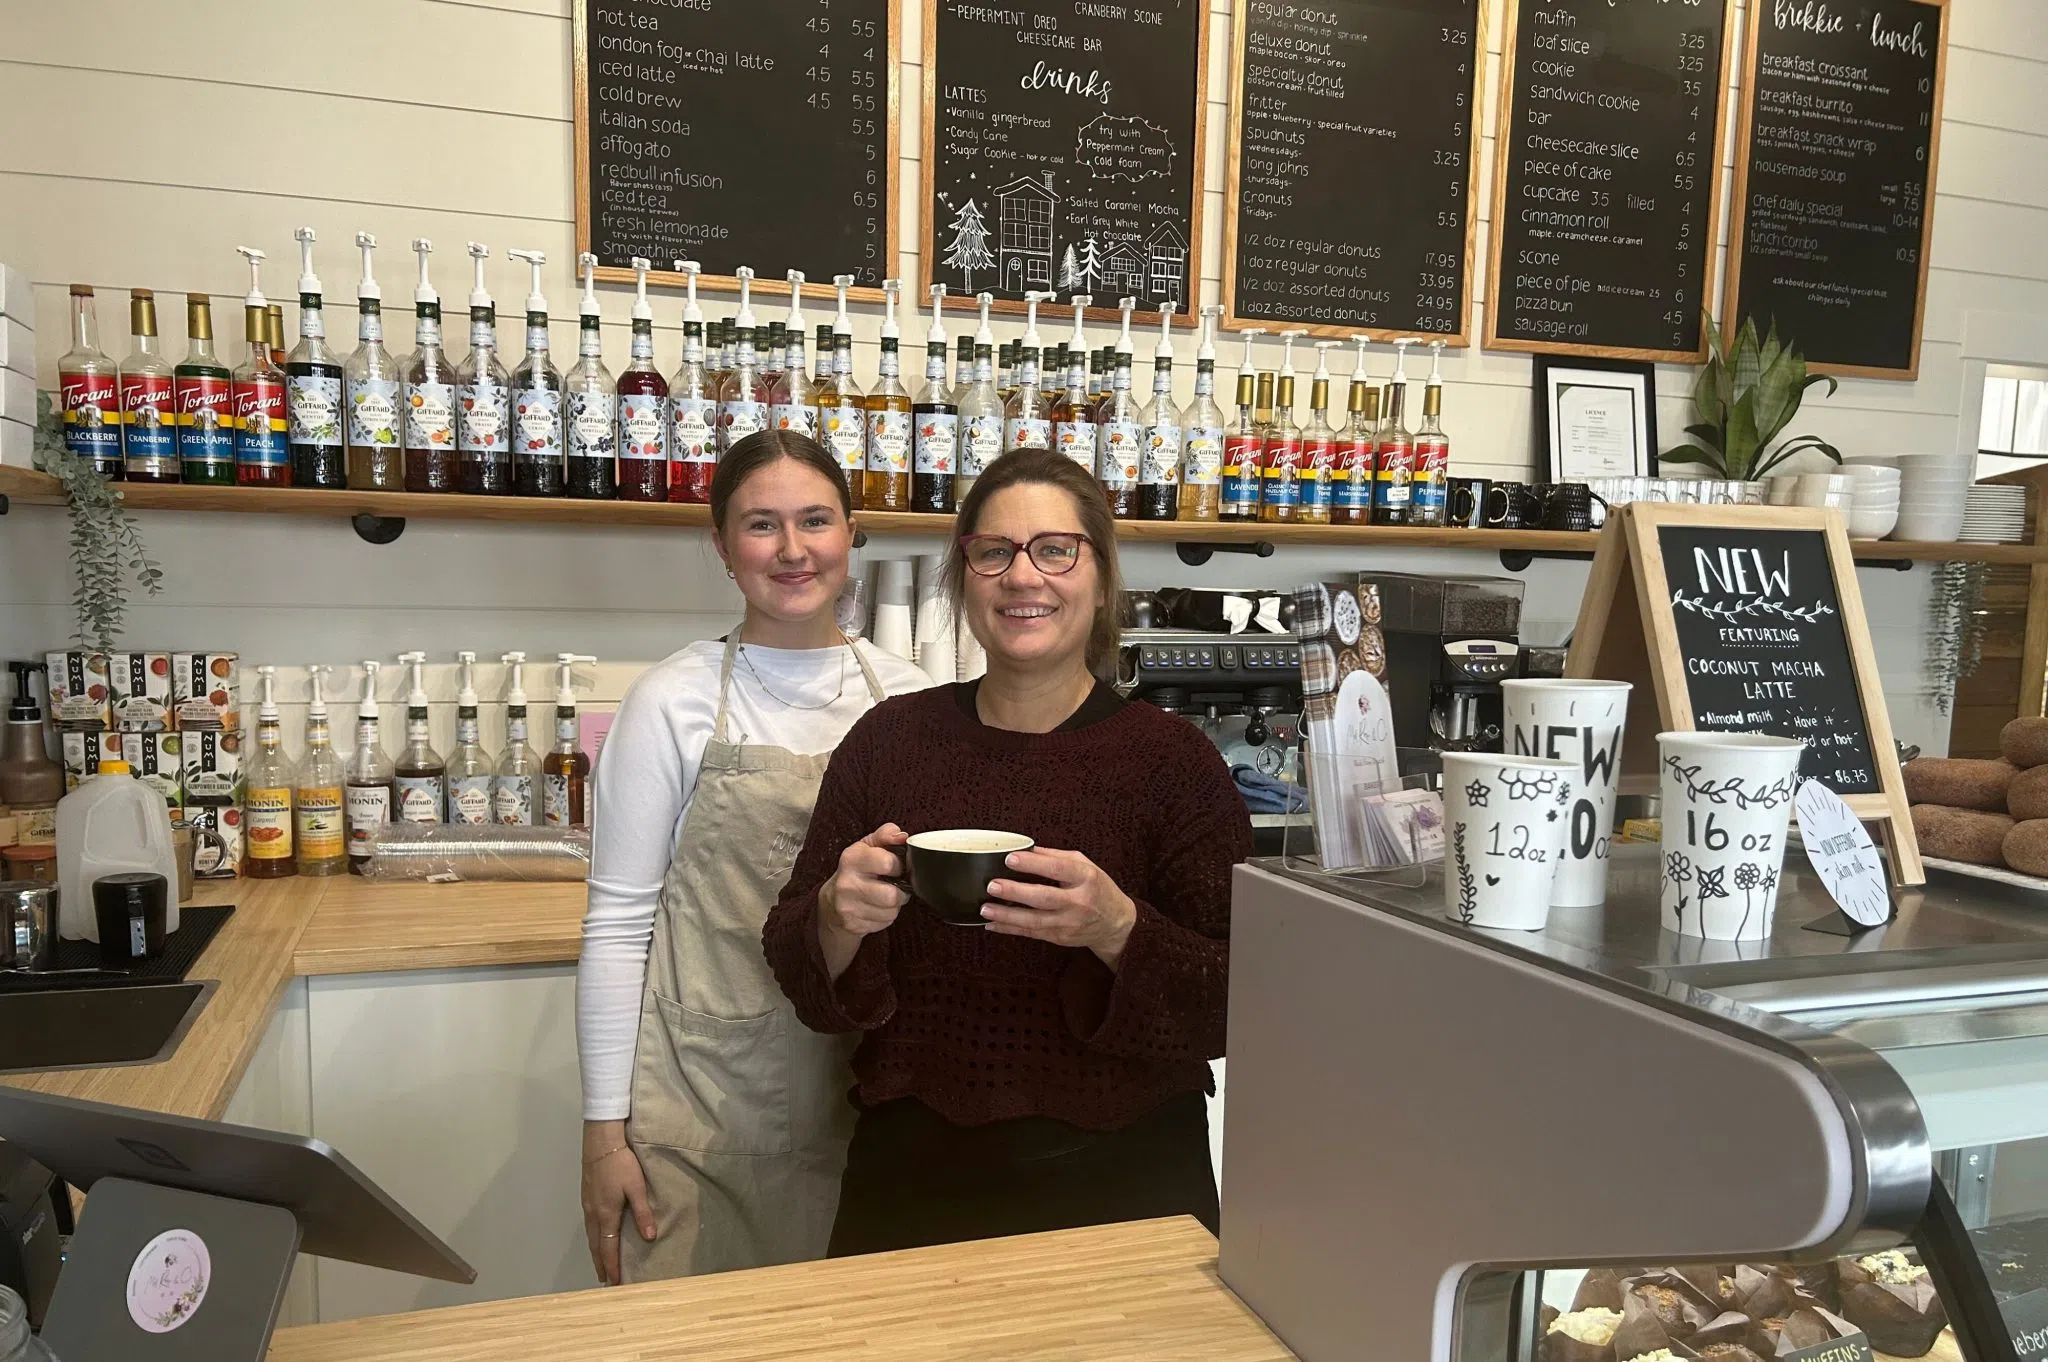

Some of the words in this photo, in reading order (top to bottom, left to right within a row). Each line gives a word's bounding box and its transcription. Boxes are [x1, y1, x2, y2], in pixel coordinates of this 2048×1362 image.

[629, 12, 658, 30] tea
[1034, 15, 1057, 31] OREO
[1075, 3, 1127, 21] CRANBERRY
[1134, 9, 1163, 26] SCONE
[1250, 1, 1298, 20] regular
[1300, 7, 1338, 26] donut
[1534, 9, 1576, 28] muffin
[852, 20, 875, 38] 5.5
[1441, 28, 1467, 45] 3.25
[1774, 0, 1844, 35] brekkie
[1869, 12, 1929, 58] lunch
[1017, 31, 1076, 49] CHEESECAKE
[1083, 37, 1102, 52] BAR
[1250, 32, 1292, 49] deluxe
[1295, 38, 1331, 56] donut
[1533, 33, 1560, 50] loaf
[1560, 38, 1590, 55] slice
[599, 33, 652, 54] london
[657, 40, 682, 63] fog
[696, 49, 727, 66] chai
[736, 51, 774, 71] latte
[1249, 46, 1273, 57] maple
[1274, 50, 1298, 61] bacon
[1327, 58, 1346, 68] oreo
[599, 62, 631, 77] iced
[637, 65, 676, 83] latte
[1532, 59, 1575, 78] cookie
[1762, 52, 1815, 73] breakfast
[1818, 61, 1869, 81] croissant
[1021, 60, 1112, 105] drinks
[1249, 64, 1305, 85] specialty
[1307, 72, 1344, 90] donut
[600, 86, 633, 103] cold
[637, 91, 682, 108] brew
[945, 85, 987, 104] LATTES
[1249, 93, 1287, 112] fritter
[1530, 84, 1595, 106] sandwich
[1597, 94, 1640, 112] cookie
[1760, 87, 1814, 108] breakfast
[1816, 97, 1853, 114] burrito
[600, 109, 647, 130] italian
[652, 119, 690, 136] soda
[951, 106, 985, 121] Vanilla
[992, 111, 1051, 129] gingerbread
[1273, 112, 1312, 129] blueberry
[1345, 122, 1362, 132] fruit
[1363, 125, 1397, 139] varieties
[1528, 108, 1552, 125] bar
[950, 127, 979, 143] Candy
[982, 129, 1008, 143] Cane
[1099, 125, 1113, 139] try
[1119, 127, 1141, 138] with
[601, 135, 671, 160] affogato
[950, 144, 979, 162] Sugar
[984, 147, 1017, 160] Cookie
[1086, 139, 1135, 154] Peppermint
[1139, 144, 1165, 156] Cream
[1527, 134, 1608, 156] cheesecake
[1610, 143, 1639, 160] slice
[1813, 130, 1844, 148] snack
[1847, 138, 1877, 157] wrap
[1094, 156, 1112, 167] Cold
[1118, 157, 1142, 168] foam
[1247, 158, 1273, 174] long
[1275, 161, 1309, 178] johns
[1524, 159, 1560, 176] piece
[1563, 162, 1578, 177] of
[1579, 164, 1612, 181] cake
[601, 163, 657, 181] redbull
[660, 168, 723, 189] infusion
[1820, 168, 1847, 184] soup
[602, 190, 635, 204] iced
[639, 192, 667, 208] tea
[853, 192, 877, 208] 6.5
[1070, 196, 1099, 209] Salted
[1105, 199, 1141, 213] Caramel
[1148, 203, 1179, 216] Mocha
[1627, 194, 1655, 211] filled
[601, 212, 646, 232] fresh
[650, 218, 729, 238] lemonade
[1070, 213, 1088, 224] Earl
[1093, 215, 1111, 229] Grey
[1115, 217, 1139, 229] White
[1437, 212, 1457, 227] 5.5
[1588, 215, 1609, 229] roll
[1084, 228, 1099, 239] Hot
[1103, 229, 1142, 242] Chocolate
[1612, 235, 1643, 246] caramel
[1264, 235, 1285, 249] doz
[1289, 239, 1334, 257] regular
[1337, 242, 1381, 258] donuts
[1896, 247, 1916, 263] 10.5
[1425, 252, 1456, 268] 17.95
[1518, 250, 1560, 266] scone
[1419, 273, 1454, 289] 33.95
[1289, 282, 1345, 298] assorted
[1348, 286, 1390, 302] donuts
[1417, 295, 1453, 311] 24.95
[1515, 296, 1548, 312] pizza
[1550, 299, 1573, 313] bun
[1416, 317, 1452, 332] 45.95
[1514, 318, 1566, 338] sausage
[1568, 323, 1589, 336] roll
[63, 383, 113, 411] Torani
[122, 385, 171, 412] Torani
[179, 387, 228, 414] Torani
[235, 391, 282, 418] Torani
[297, 402, 327, 410] GIFFARD
[360, 405, 390, 413] GIFFARD
[469, 410, 497, 418] GIFFARD
[66, 431, 118, 442] BLACKBERRY
[129, 435, 170, 444] CRANBERRY
[181, 434, 209, 444] GREEN
[211, 436, 233, 445] APPLE
[245, 438, 274, 448] PEACH
[879, 434, 904, 442] GIFFARD
[1693, 547, 1790, 597] NEW
[1719, 628, 1800, 642] FEATURING
[69, 656, 83, 691] NUMI
[132, 658, 144, 692] NUMI
[193, 659, 205, 692] NUMI
[1688, 658, 1760, 677] COCONUT
[1772, 661, 1825, 678] MACHA
[1744, 681, 1796, 699] LATTE
[1707, 710, 1744, 725] Almond
[1747, 709, 1774, 723] milk
[1794, 716, 1818, 728] Have
[1825, 715, 1834, 725] it
[1821, 737, 1831, 746] or
[1834, 733, 1853, 745] hot
[144, 737, 156, 770] NUMI
[203, 734, 214, 767] NUMI
[1835, 769, 1868, 783] $6.75
[1687, 810, 1729, 851] 16
[1741, 832, 1772, 852] oz
[1486, 822, 1529, 860] 12
[1528, 848, 1546, 862] oz
